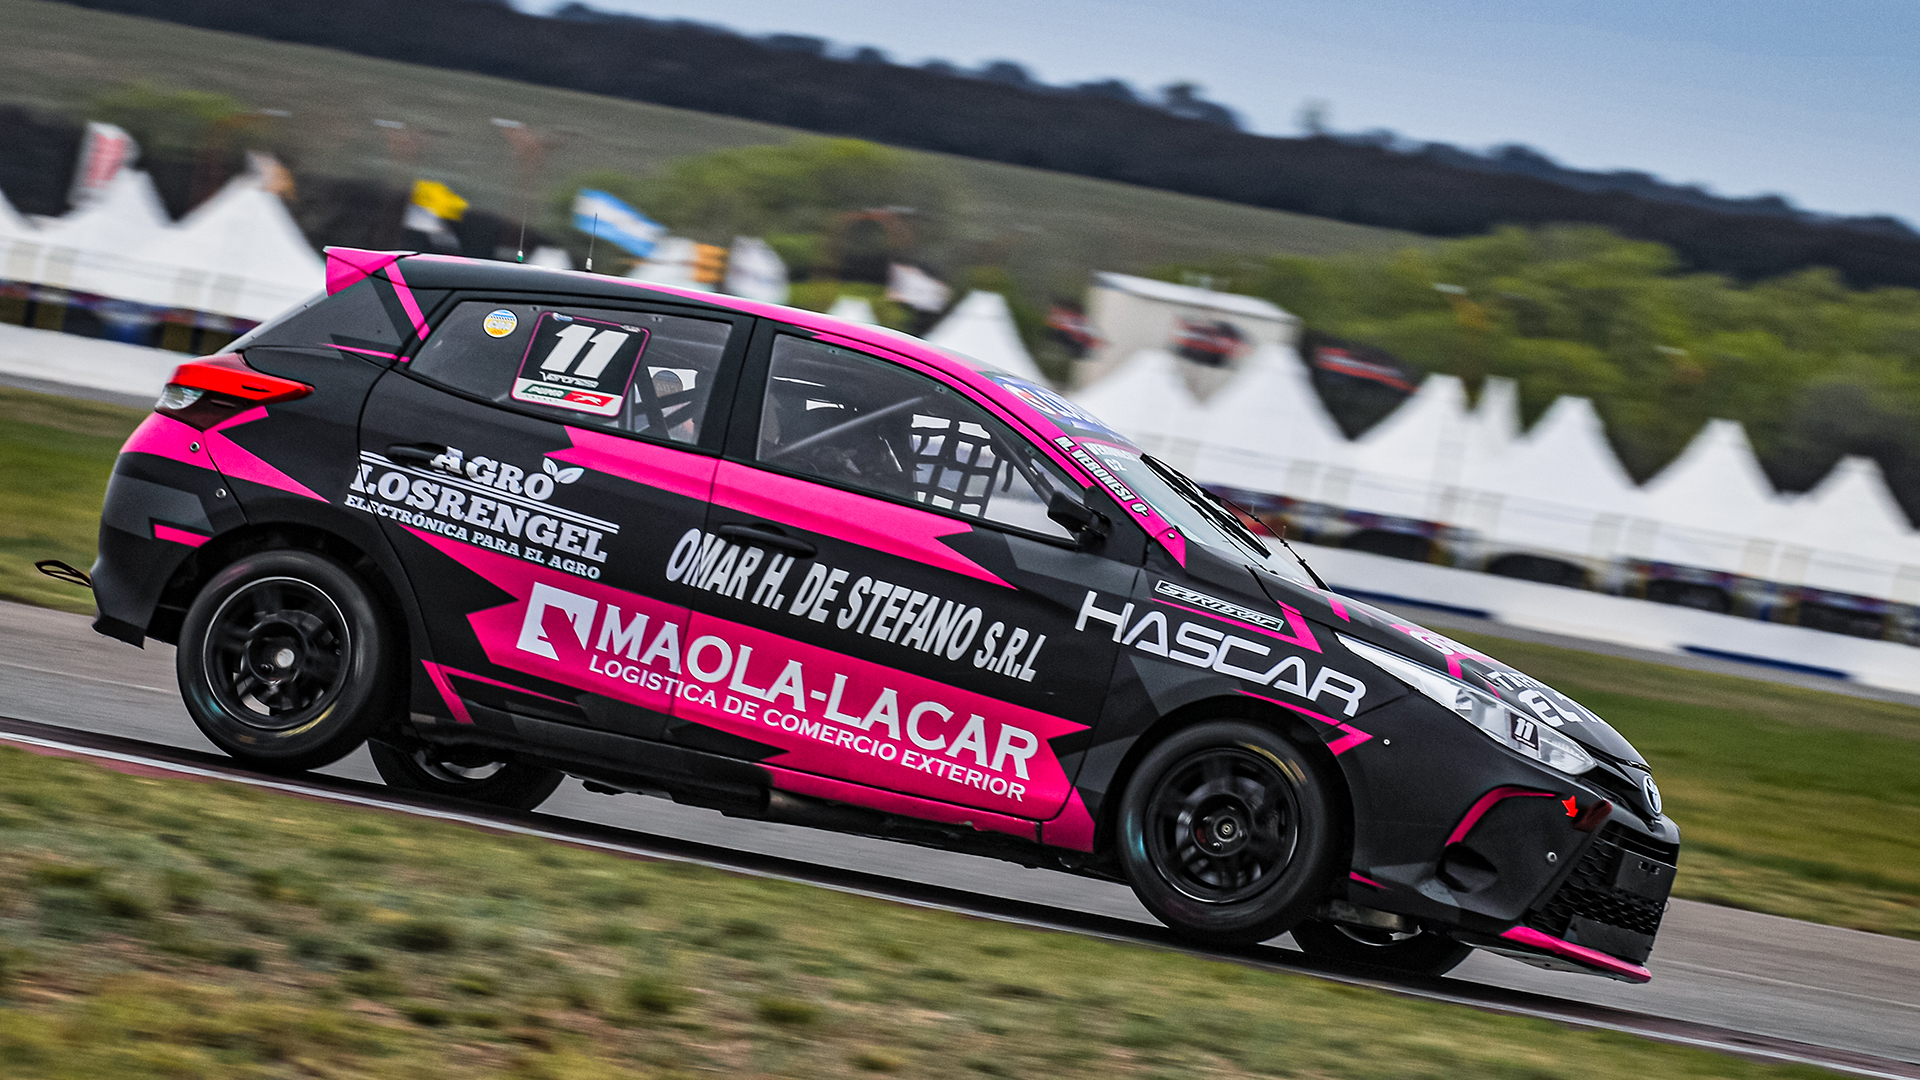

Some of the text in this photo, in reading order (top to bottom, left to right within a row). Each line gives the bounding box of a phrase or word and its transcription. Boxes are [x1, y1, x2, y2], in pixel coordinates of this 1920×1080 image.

[540, 323, 630, 379] 11
[349, 463, 608, 563] LOSRENGEL
[430, 446, 555, 501] AGRO
[1054, 436, 1076, 452] M.
[1070, 449, 1137, 501] VERONESI
[344, 493, 600, 580] ELECTRÓNICA PARA EL AGRO
[665, 527, 1047, 683] OMAR H. DE STEFANO S.R.L
[595, 603, 1039, 781] MAOLA-LACAR
[1075, 590, 1367, 718] HASCAR
[589, 654, 1026, 803] LOGISTICA DE COMERCIO EXTERIOR
[1514, 717, 1535, 741] 11
